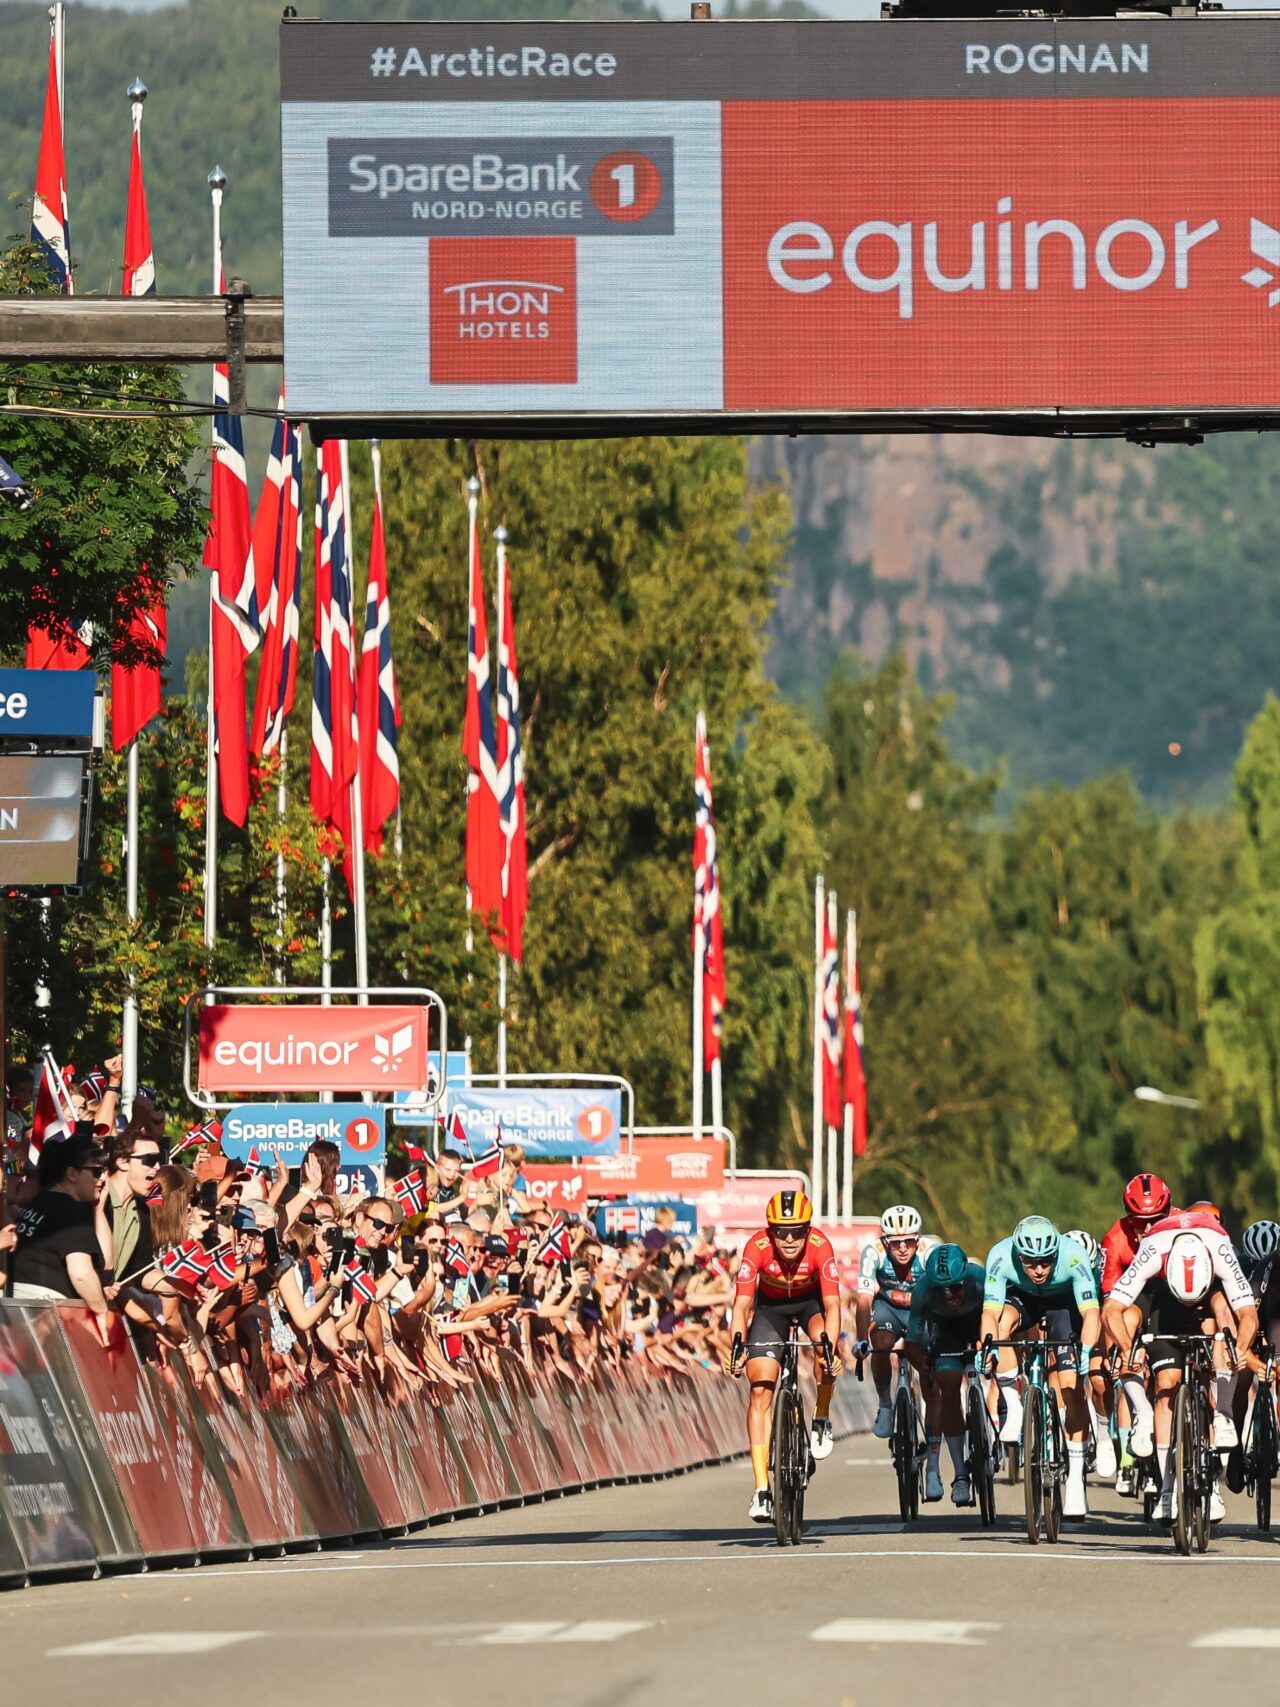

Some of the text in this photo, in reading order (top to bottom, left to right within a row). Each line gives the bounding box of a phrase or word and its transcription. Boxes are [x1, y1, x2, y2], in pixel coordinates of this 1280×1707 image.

[370, 45, 618, 78] #ArcticRace
[965, 42, 1150, 74] ROGNAN
[348, 153, 636, 210] SpareBank 1
[411, 200, 584, 220] NORD-NORGE
[766, 196, 1221, 319] equinor
[450, 284, 556, 315] THON
[458, 320, 550, 339] HOTELS
[214, 1033, 359, 1074] equinor
[227, 1118, 368, 1146] SpareBank 1
[452, 1103, 602, 1137] SpareBank 1
